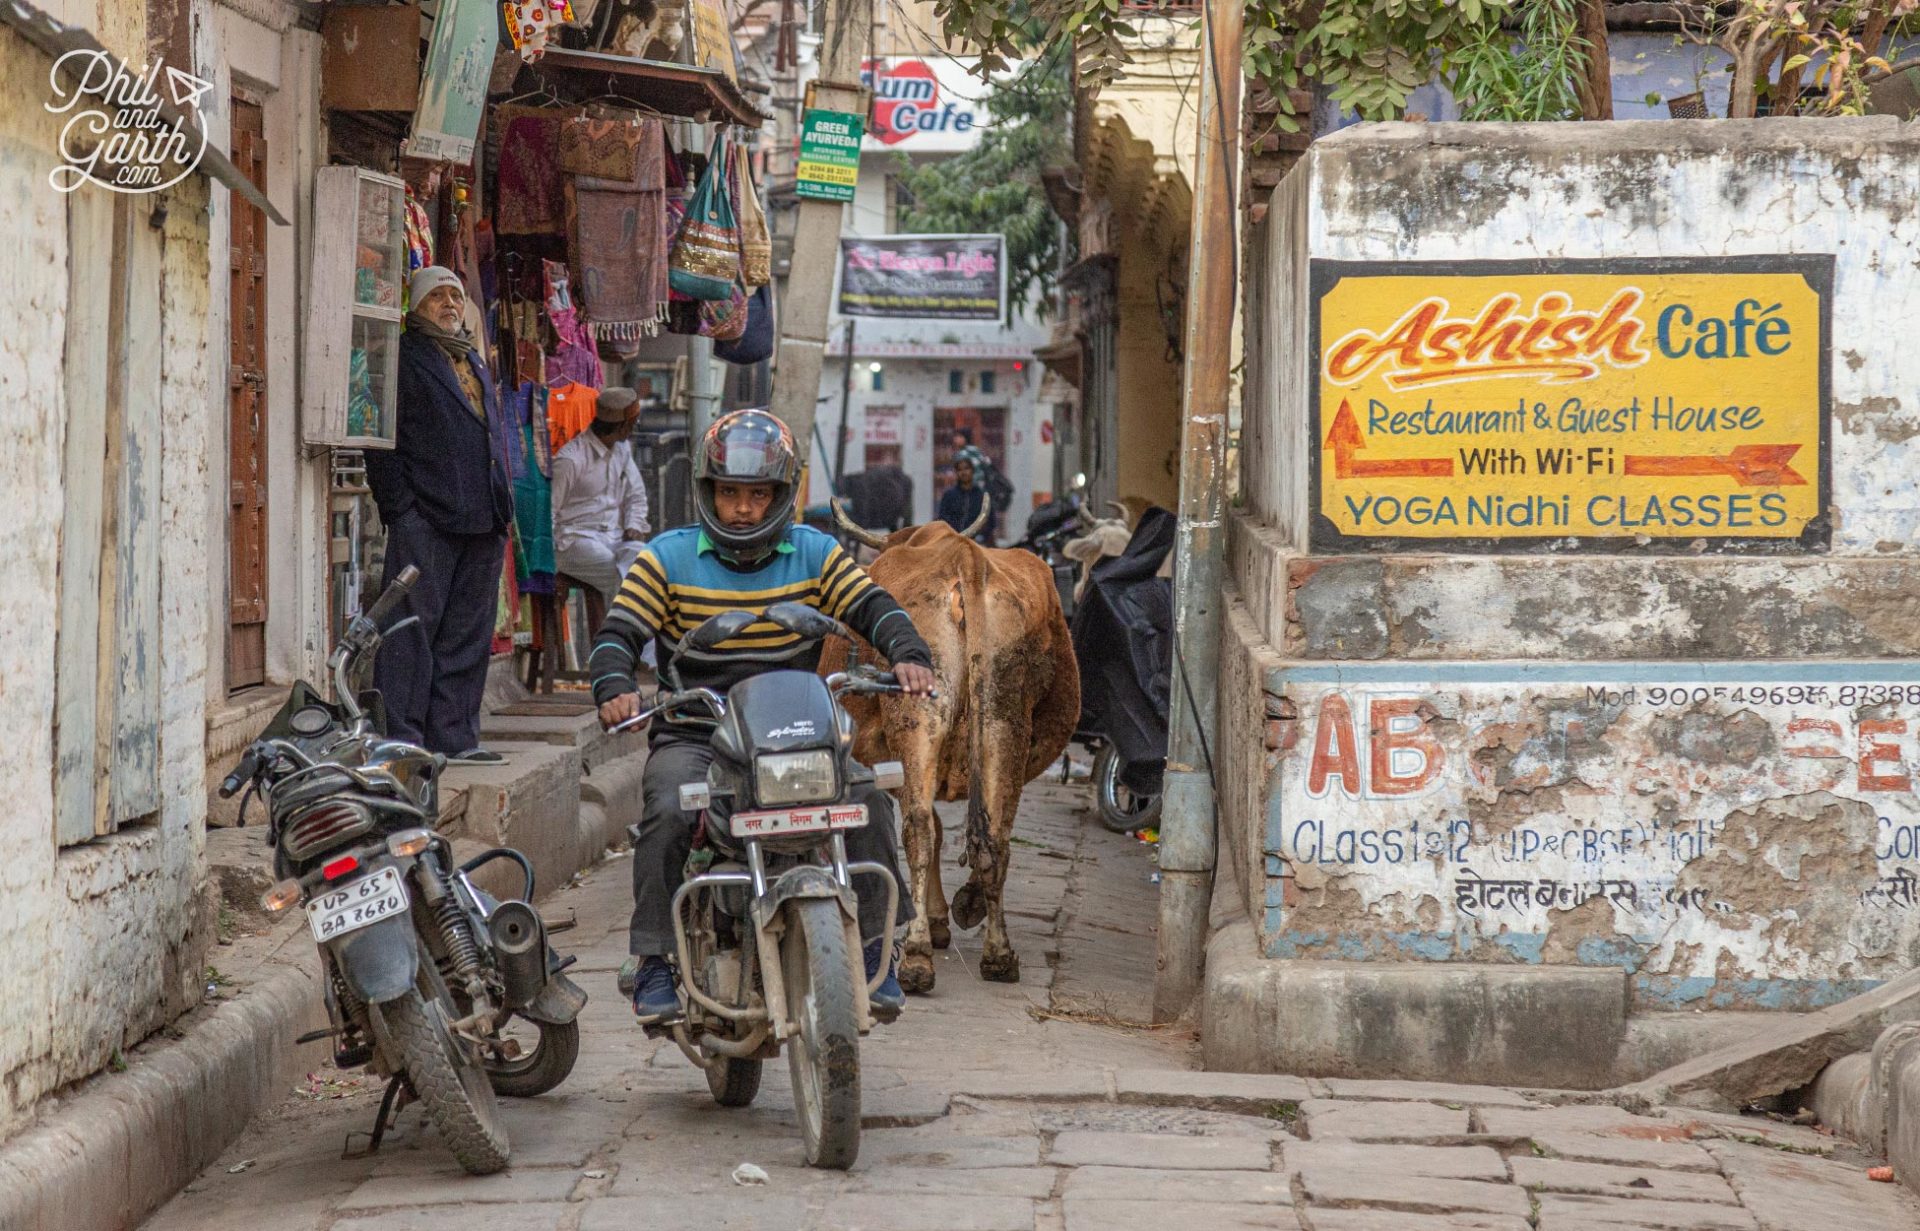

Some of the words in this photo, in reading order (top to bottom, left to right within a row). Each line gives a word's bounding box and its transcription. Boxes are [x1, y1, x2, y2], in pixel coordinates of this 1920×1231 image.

[815, 120, 849, 135] GREEN
[895, 103, 974, 132] Cafe
[805, 132, 859, 148] AYURVEDA
[1325, 287, 1651, 390] Ashish
[1657, 298, 1792, 361] Café
[1367, 398, 1527, 436] Restaurant
[1533, 408, 1551, 430] &
[1557, 397, 1641, 434] Guest
[1652, 399, 1765, 433] House
[1459, 447, 1527, 477] With
[1536, 446, 1615, 476] Wi-Fi
[1344, 495, 1461, 527] YOGA
[1466, 494, 1570, 528] Nidhi
[1586, 493, 1789, 528] CLASSES
[744, 818, 763, 832] नगर
[788, 811, 813, 826] निगम
[323, 892, 349, 910] UP
[359, 878, 381, 897] 65
[1454, 867, 1534, 918] होटल
[321, 915, 346, 935] BA
